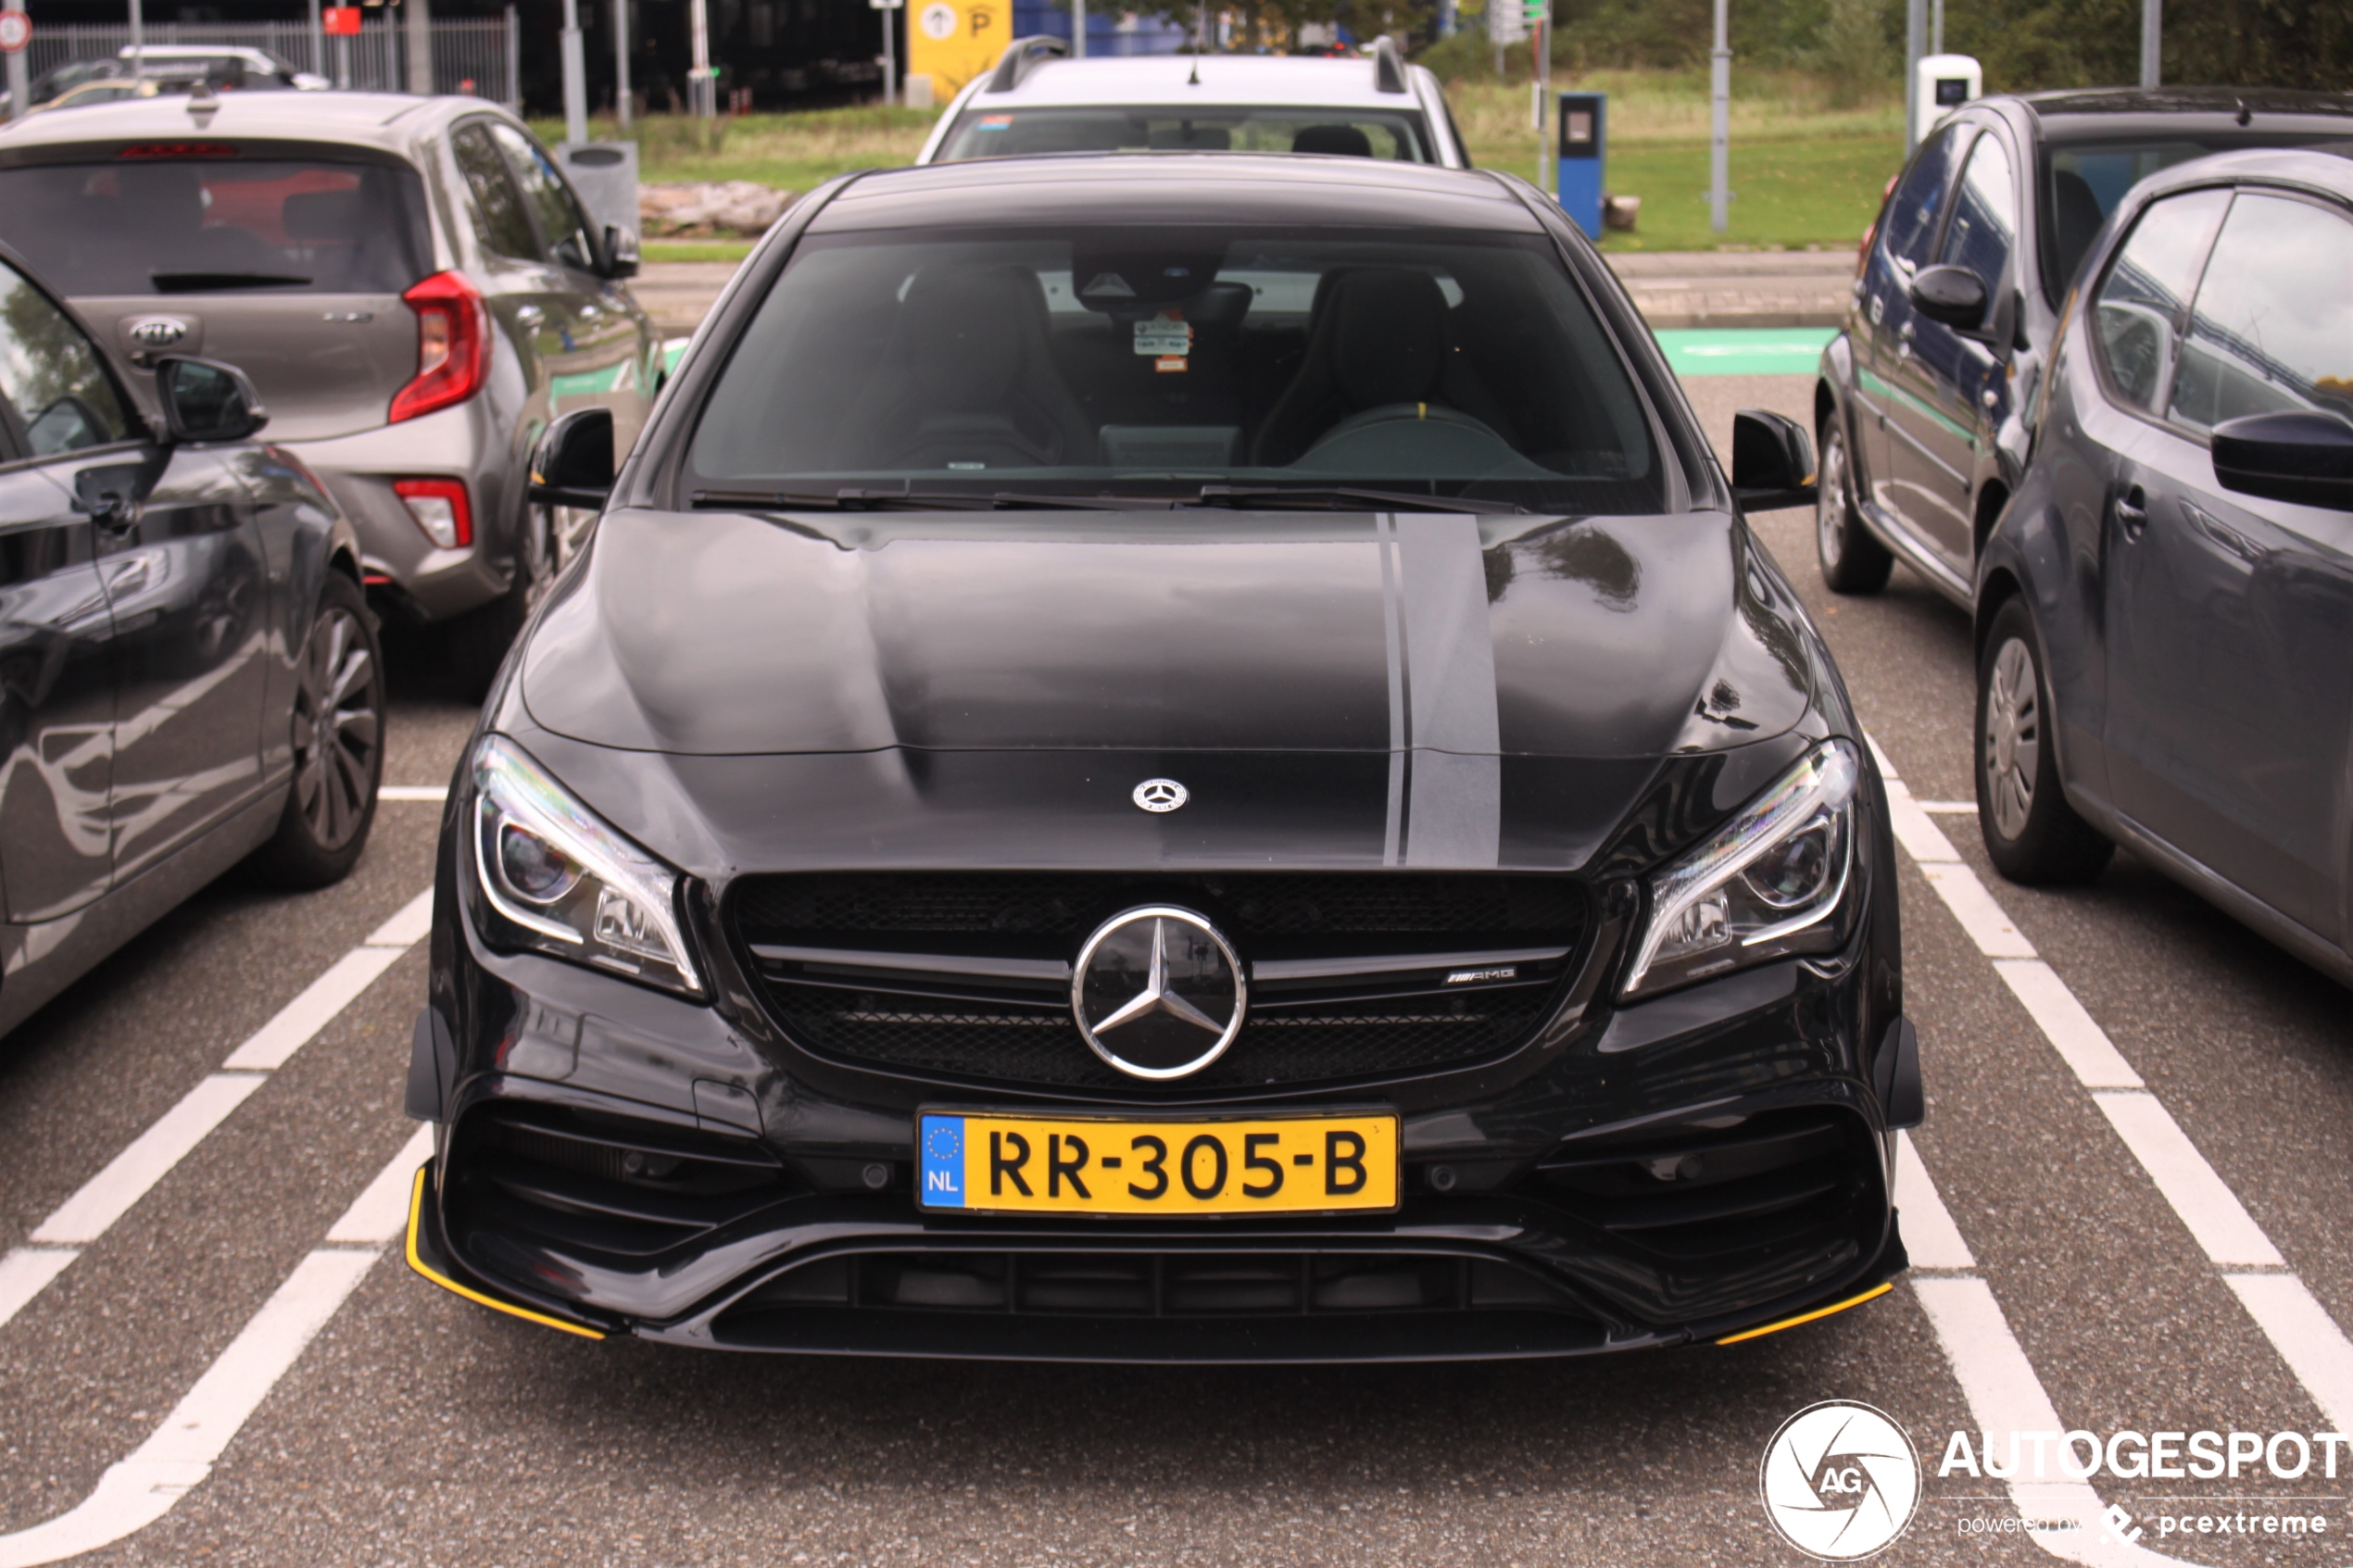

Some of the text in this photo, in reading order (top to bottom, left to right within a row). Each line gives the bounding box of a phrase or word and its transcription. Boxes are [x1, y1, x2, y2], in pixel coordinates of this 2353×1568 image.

[970, 12, 991, 38] P
[988, 1130, 1368, 1200] RR-305-B
[928, 1170, 959, 1192] NL
